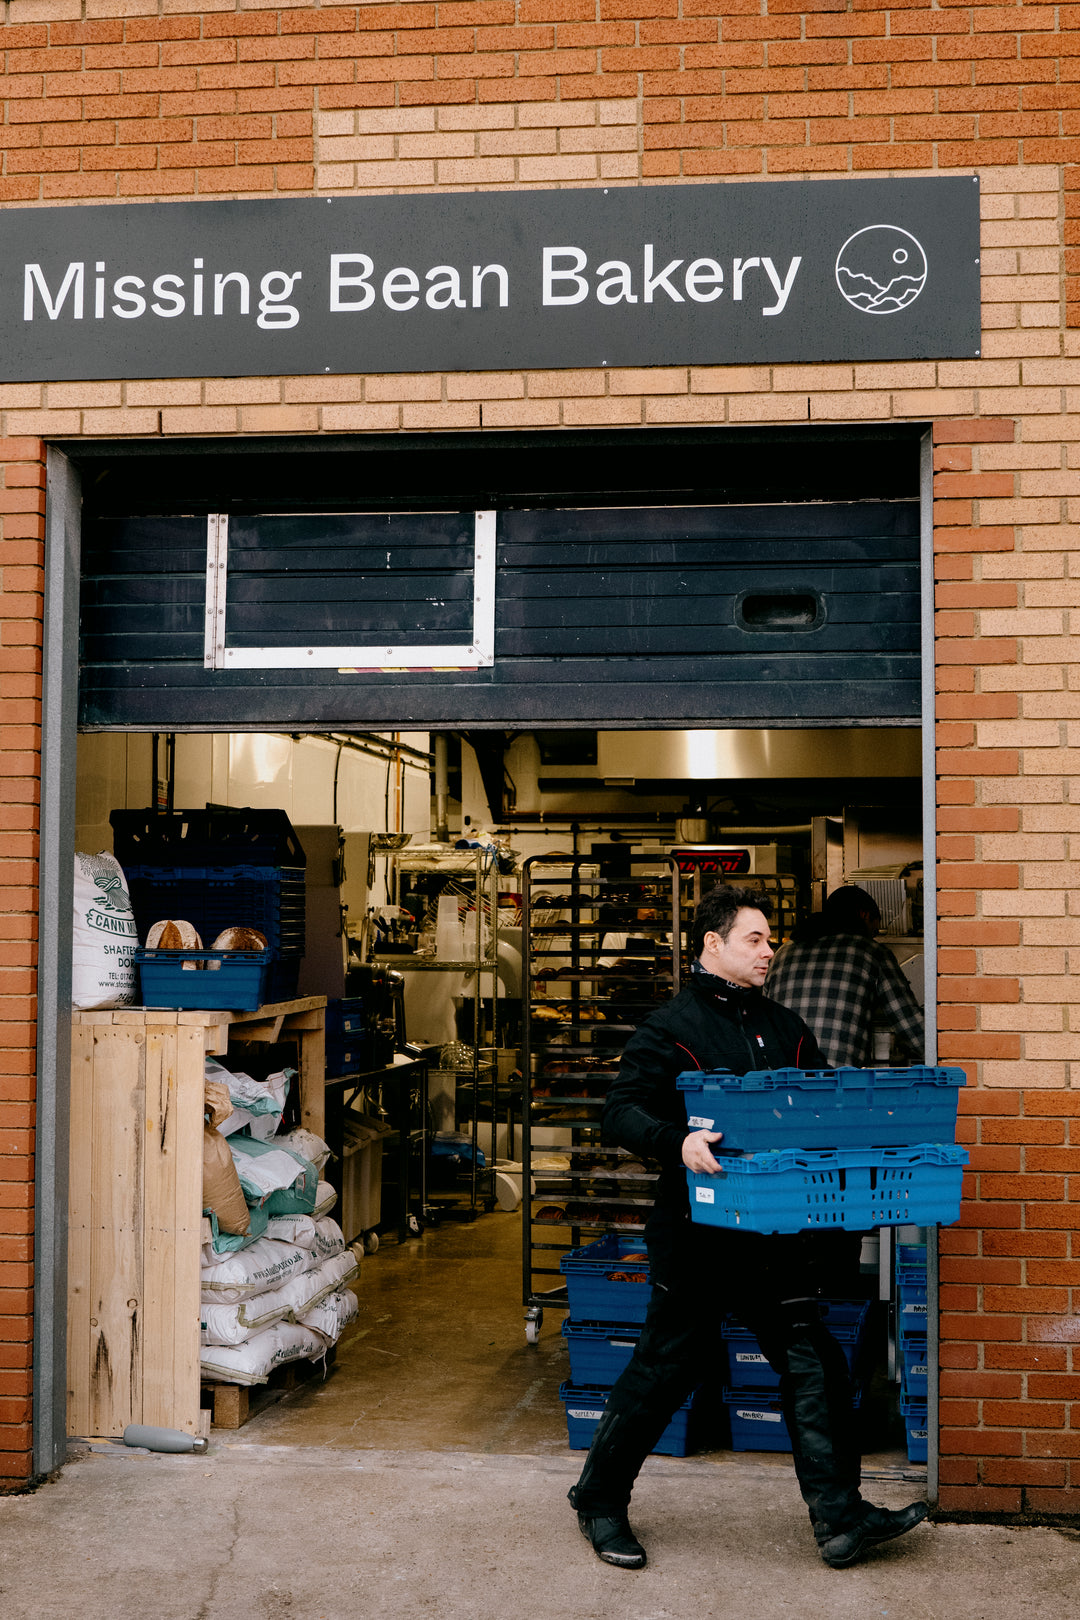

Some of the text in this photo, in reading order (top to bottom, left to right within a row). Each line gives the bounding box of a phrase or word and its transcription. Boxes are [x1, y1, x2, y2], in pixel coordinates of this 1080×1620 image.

[23, 243, 802, 330] Missing Bean Bakery
[95, 914, 125, 933] CANN
